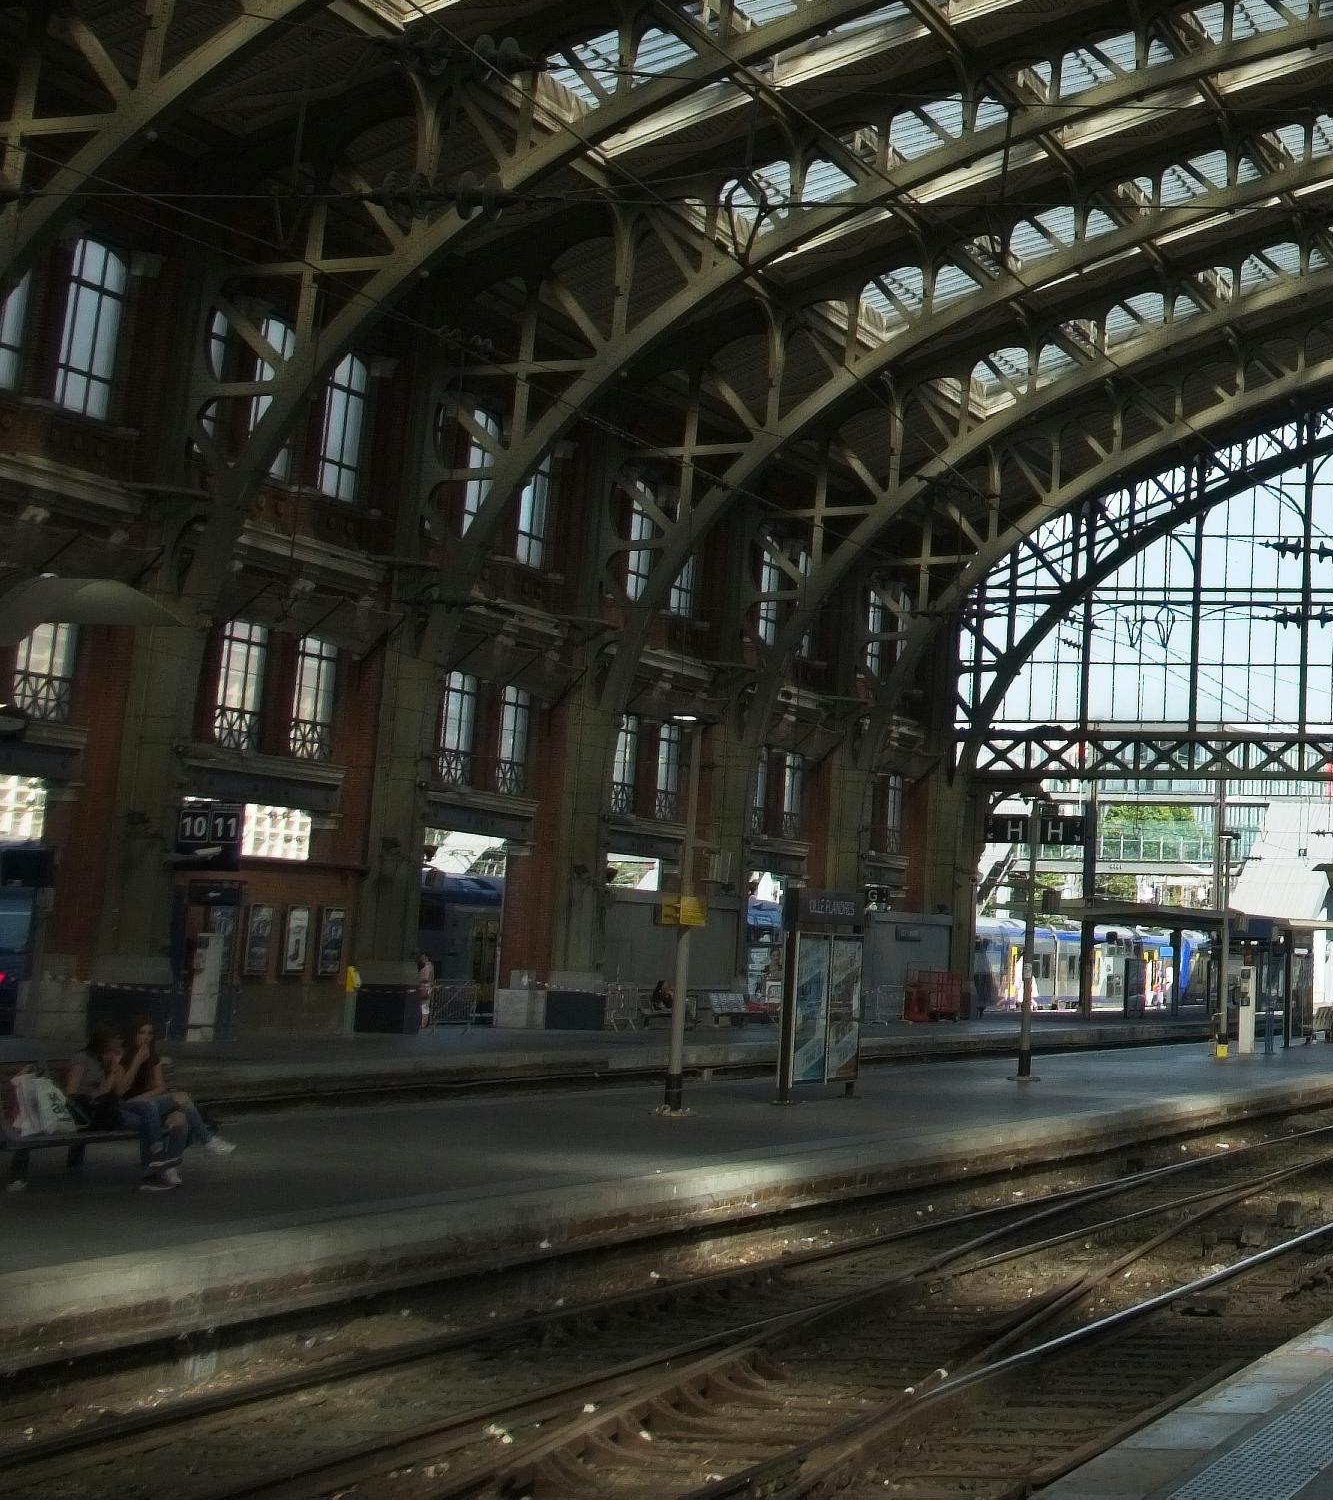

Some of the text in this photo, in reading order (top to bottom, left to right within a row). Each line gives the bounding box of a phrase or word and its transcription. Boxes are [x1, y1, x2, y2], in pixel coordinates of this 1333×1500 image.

[182, 816, 208, 838] 10
[214, 817, 237, 838] 11
[1007, 820, 1023, 841] H
[1047, 820, 1064, 842] H
[868, 889, 878, 901] G
